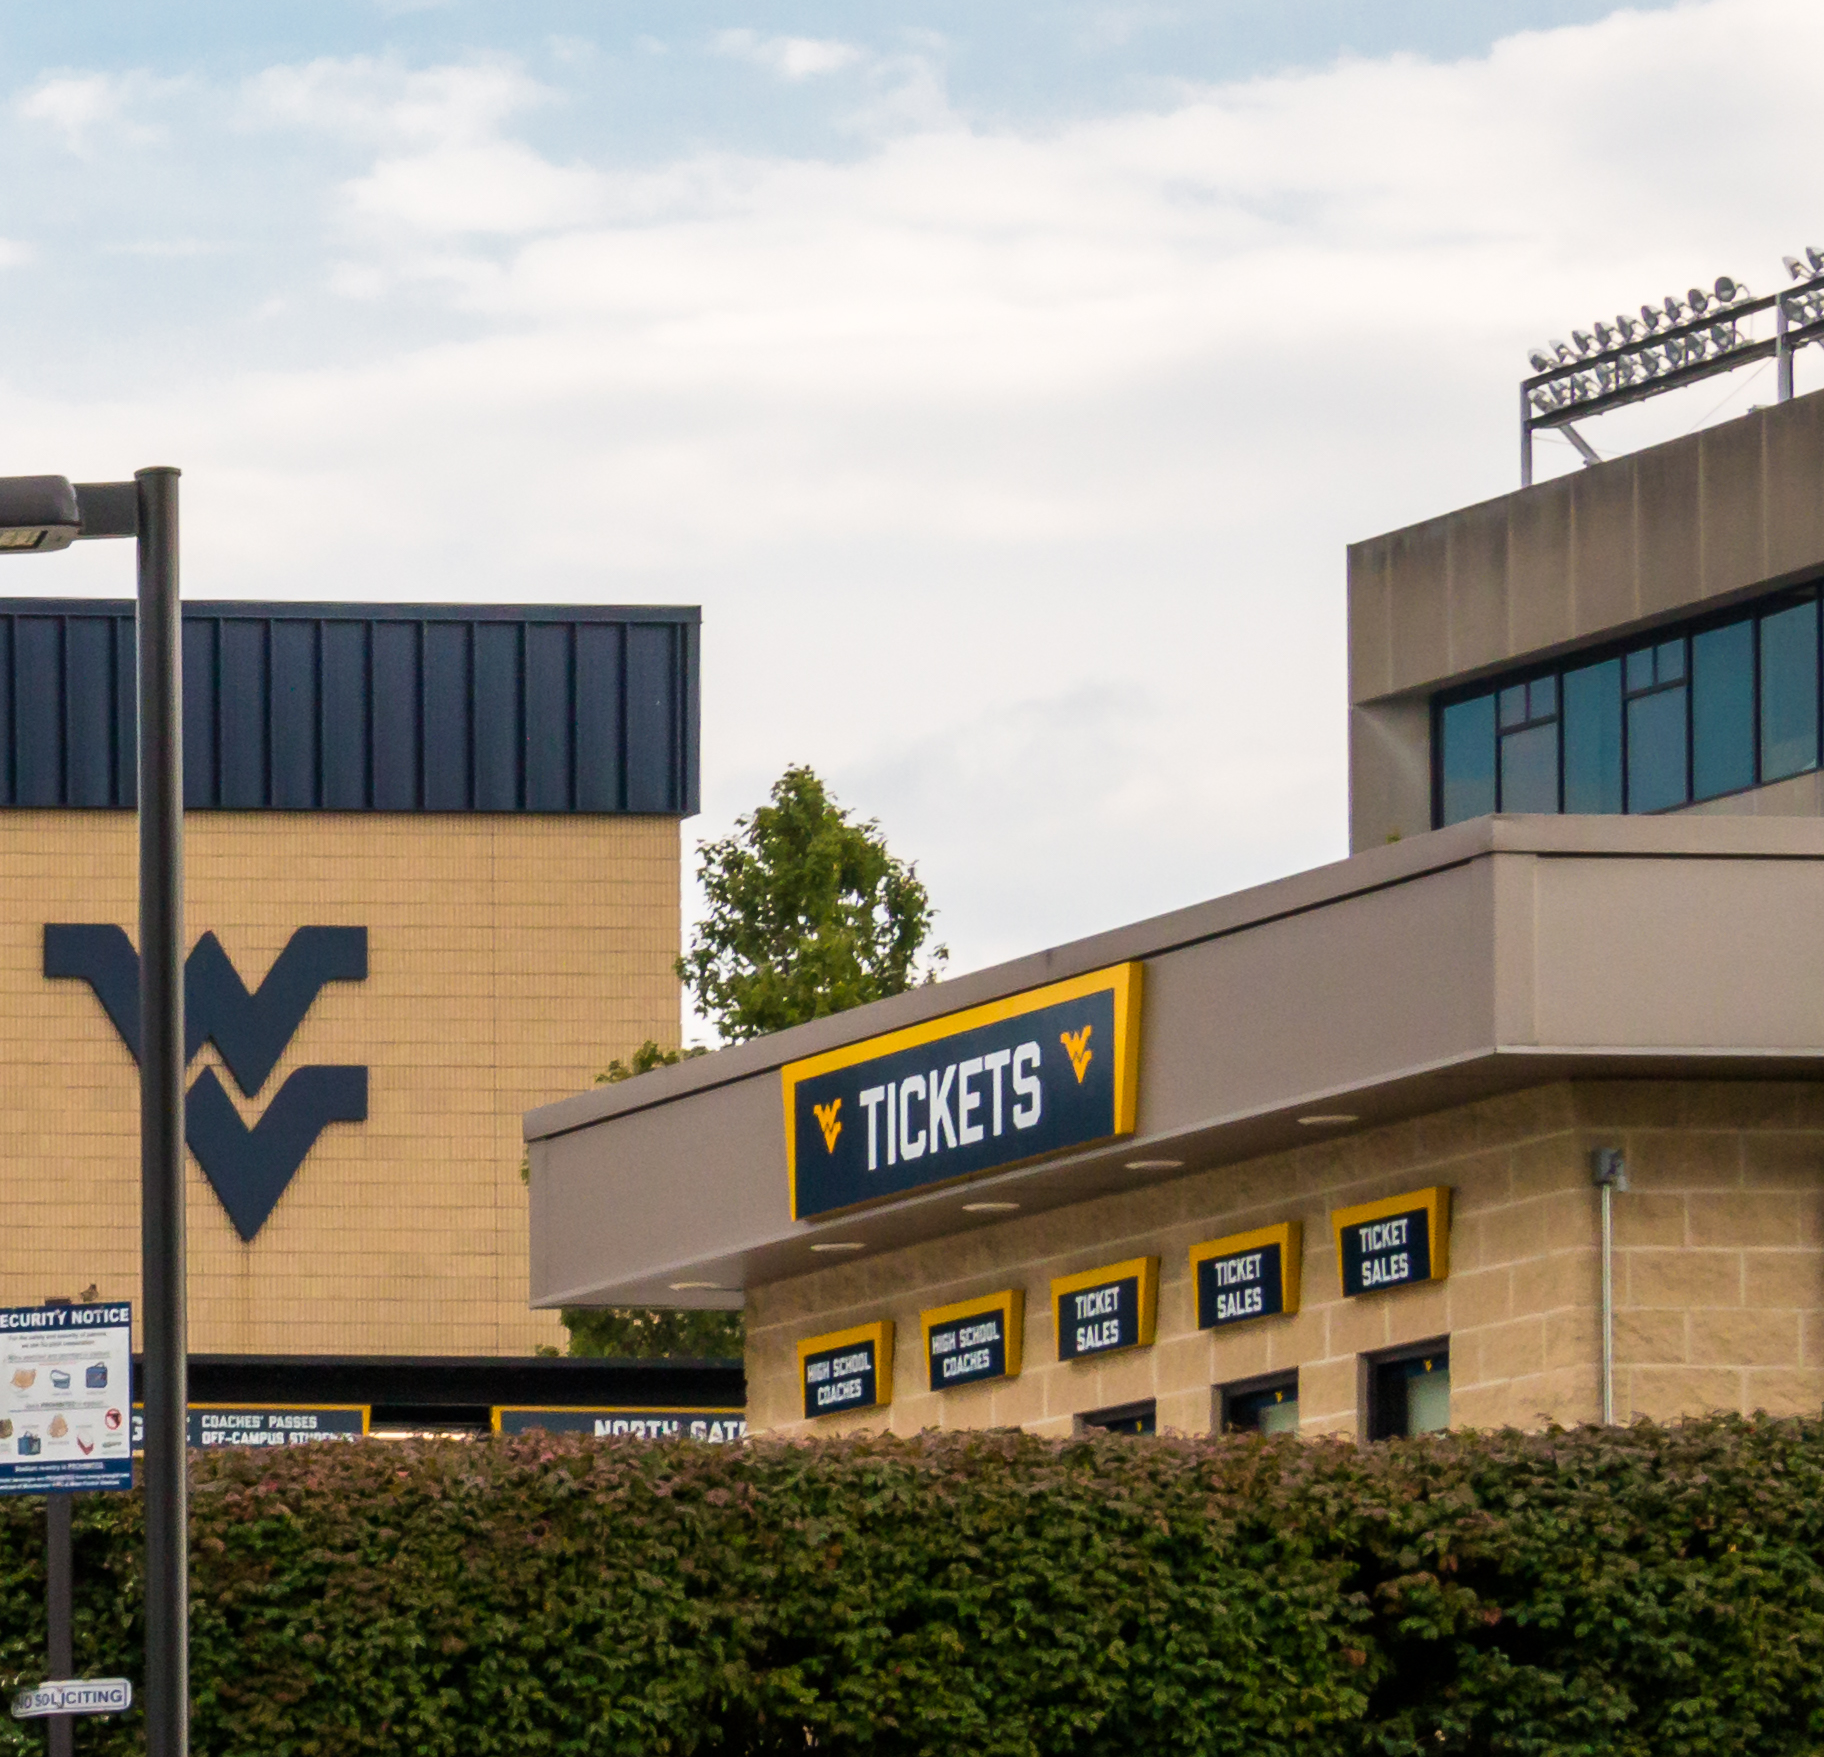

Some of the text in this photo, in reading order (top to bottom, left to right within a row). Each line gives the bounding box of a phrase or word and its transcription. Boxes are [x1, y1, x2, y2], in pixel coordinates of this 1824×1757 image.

[859, 1040, 1042, 1171] TICKETS
[1359, 1218, 1409, 1253] TICKET
[1215, 1253, 1263, 1287] TICKET
[1361, 1252, 1410, 1287] SALES
[71, 1307, 130, 1325] NOTICE
[1075, 1286, 1120, 1320] TICKET
[1216, 1286, 1263, 1320] SALES
[932, 1320, 1001, 1355] HIGH SCHOOL
[1076, 1318, 1120, 1352] SALES
[807, 1351, 872, 1384] HIGH SCHOOL
[942, 1348, 991, 1379] COACHES
[816, 1378, 863, 1406] COACHES
[201, 1430, 285, 1445] OFF-CAMPUS
[268, 1415, 318, 1430] PASSES
[35, 1688, 124, 1708] SOLICITING
